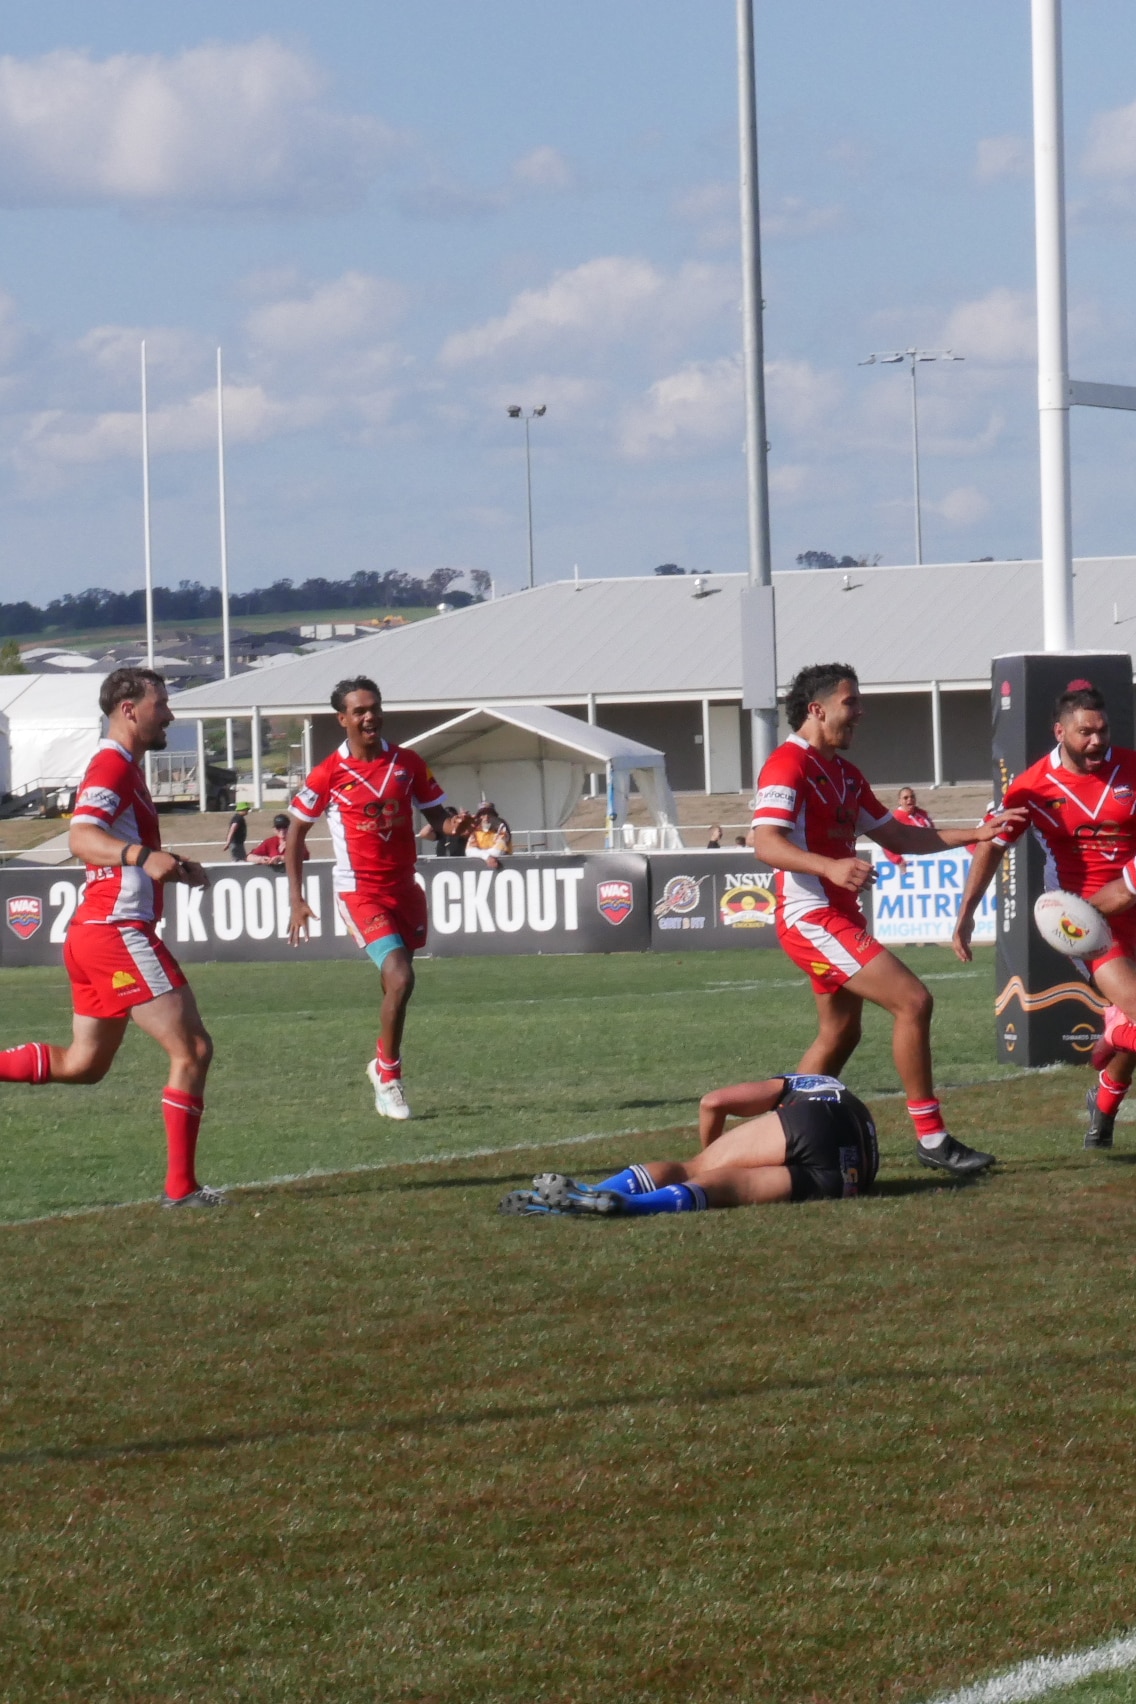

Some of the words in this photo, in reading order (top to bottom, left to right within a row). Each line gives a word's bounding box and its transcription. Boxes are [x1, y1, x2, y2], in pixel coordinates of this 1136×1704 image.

[724, 873, 774, 890] NSW
[876, 859, 970, 890] PETRI
[600, 884, 630, 898] WAC
[9, 900, 39, 913] WAC
